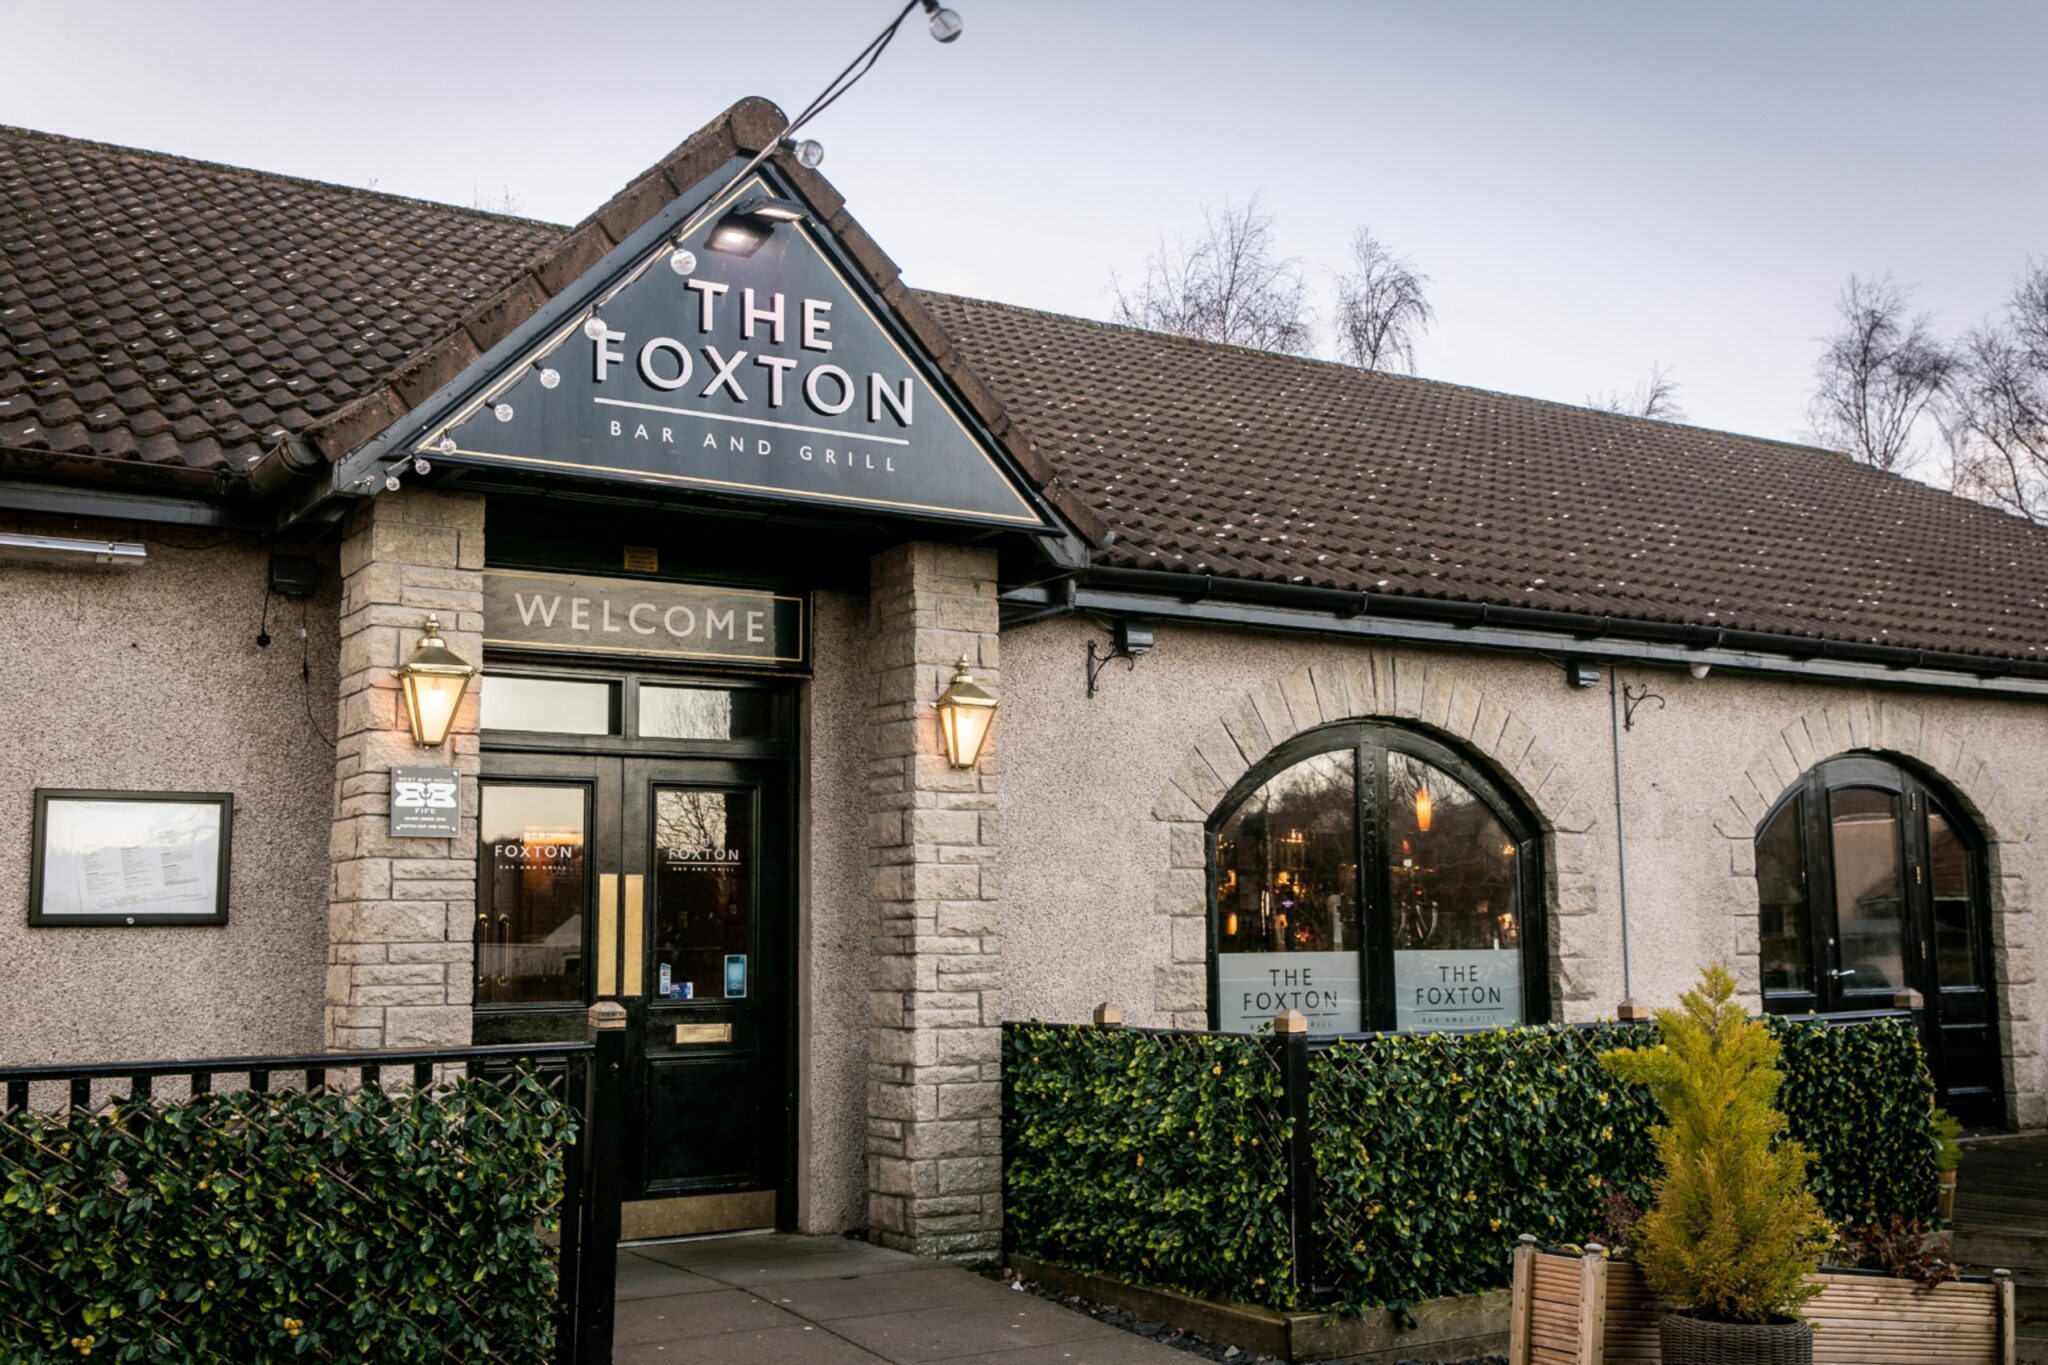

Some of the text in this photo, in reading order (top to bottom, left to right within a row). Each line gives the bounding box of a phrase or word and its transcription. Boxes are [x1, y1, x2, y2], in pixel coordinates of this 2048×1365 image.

[689, 278, 833, 351] THE
[596, 330, 914, 426] FOXTON
[610, 421, 895, 471] BAR AND GRILL
[515, 593, 765, 642] WELCOME
[414, 807, 437, 815] FIFE
[494, 844, 573, 858] FOXTON
[668, 847, 739, 861] FOXTON
[1268, 968, 1312, 987] THE
[1438, 965, 1479, 982] THE
[1243, 990, 1337, 1011] FOXTON
[1416, 986, 1501, 1005] FOXTON
